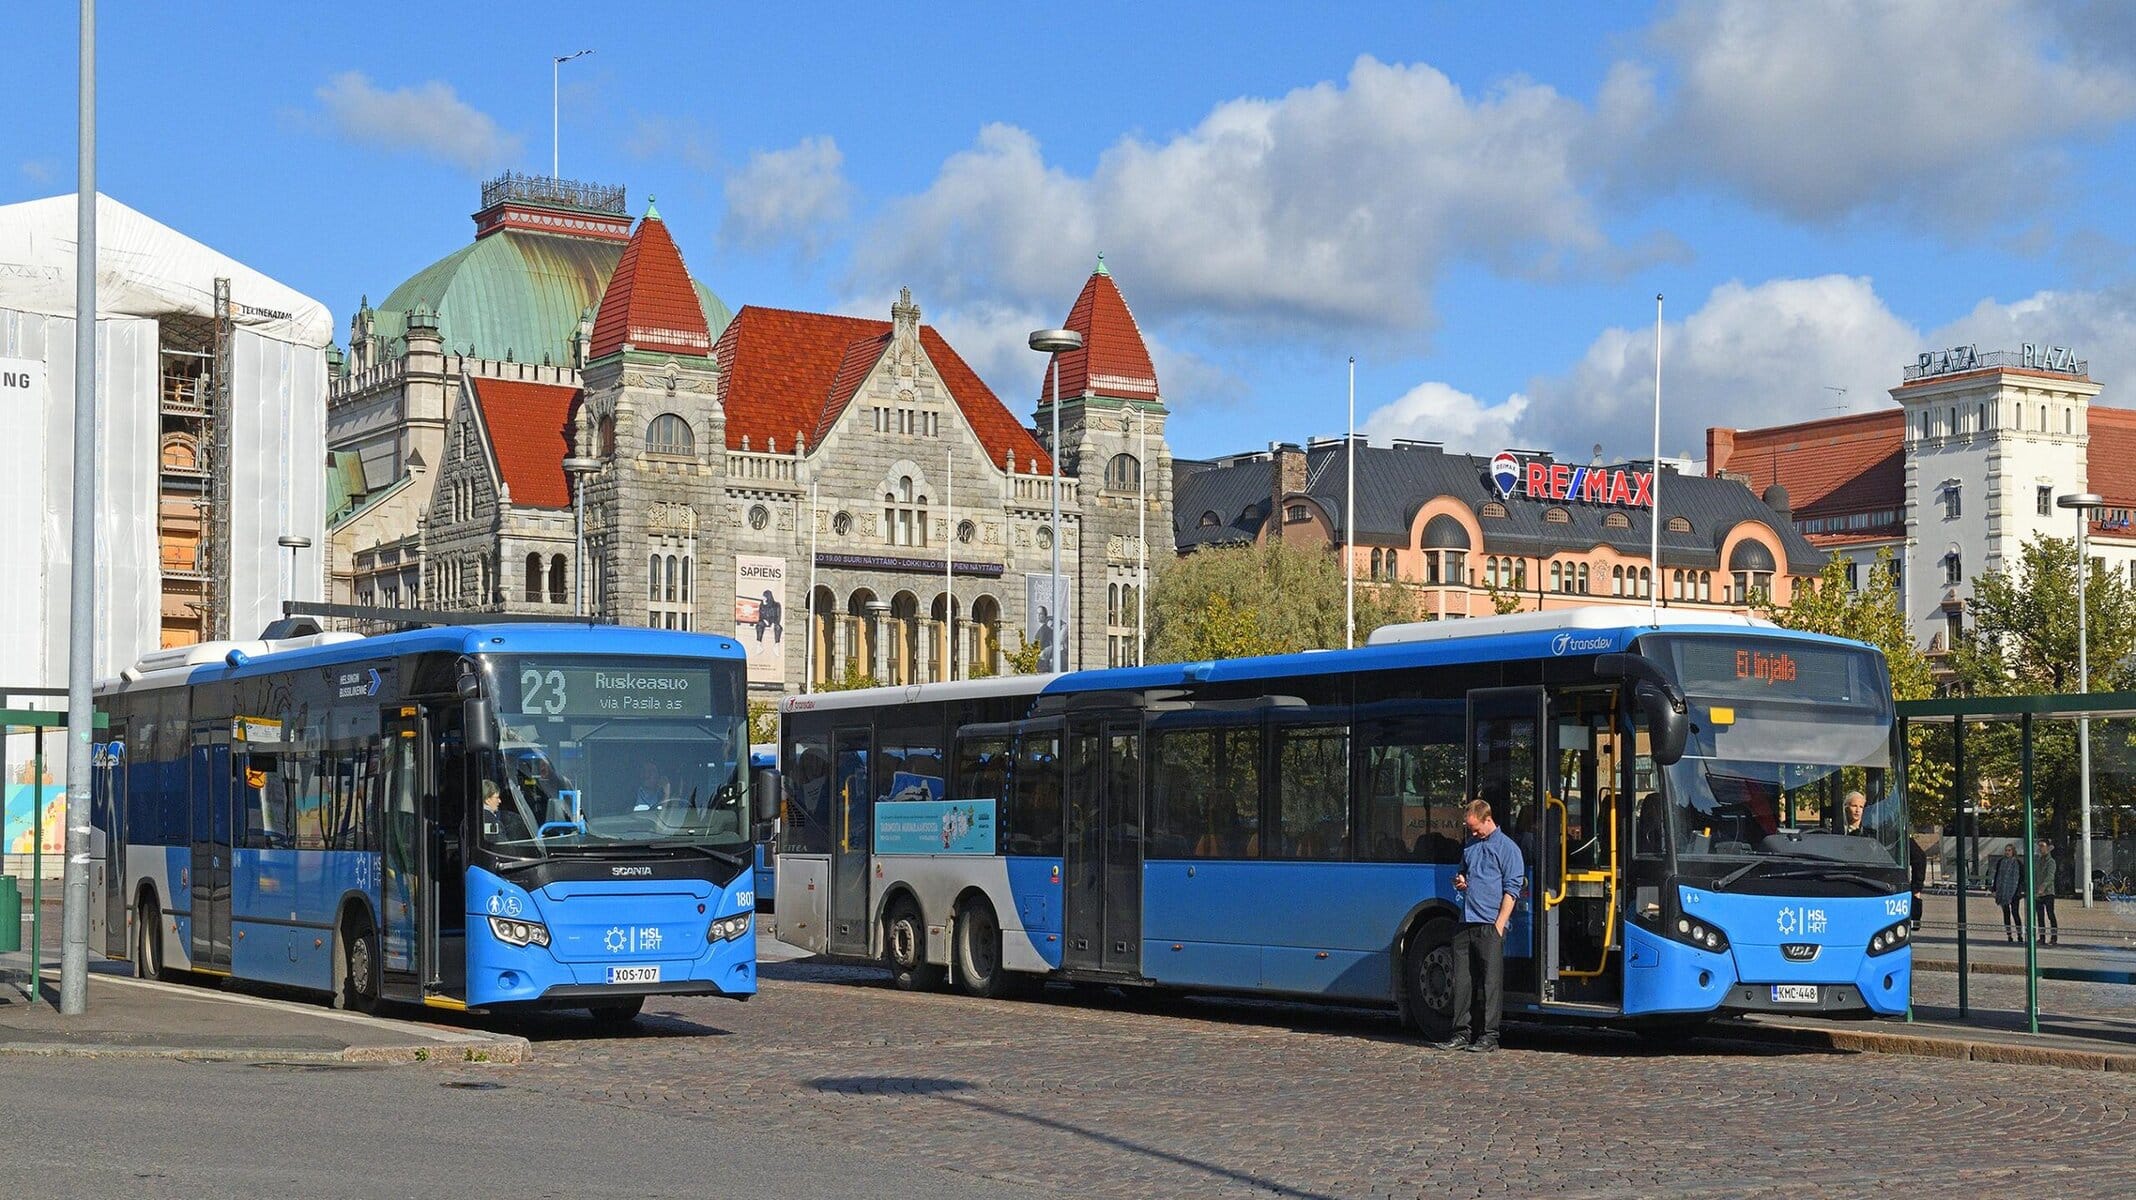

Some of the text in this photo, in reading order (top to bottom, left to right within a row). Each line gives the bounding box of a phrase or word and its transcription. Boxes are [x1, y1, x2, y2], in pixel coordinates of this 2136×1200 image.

[1918, 343, 1982, 377] PLAZA
[2021, 342, 2079, 373] PLAZA
[3, 371, 30, 389] NG
[1526, 461, 1655, 507] RE/MAX
[902, 559, 922, 567] LOKKI
[922, 560, 936, 568] KLO
[740, 566, 782, 579] SAPIENS
[1570, 636, 1613, 651] transdev
[1736, 650, 1796, 687] Ei linjalla
[595, 672, 689, 690] Ruskeasuo
[520, 669, 567, 715] 23
[600, 695, 683, 710] via Pasila as
[611, 867, 653, 876] SCANIA
[1884, 899, 1908, 916] 1246
[1807, 909, 1827, 921] HSL
[639, 927, 662, 939] HSL
[1807, 921, 1828, 933] HRT
[639, 938, 662, 950] HRT
[1786, 945, 1814, 956] VDL
[615, 968, 657, 981] XOS-707
[1778, 987, 1816, 1000] KMC-448
